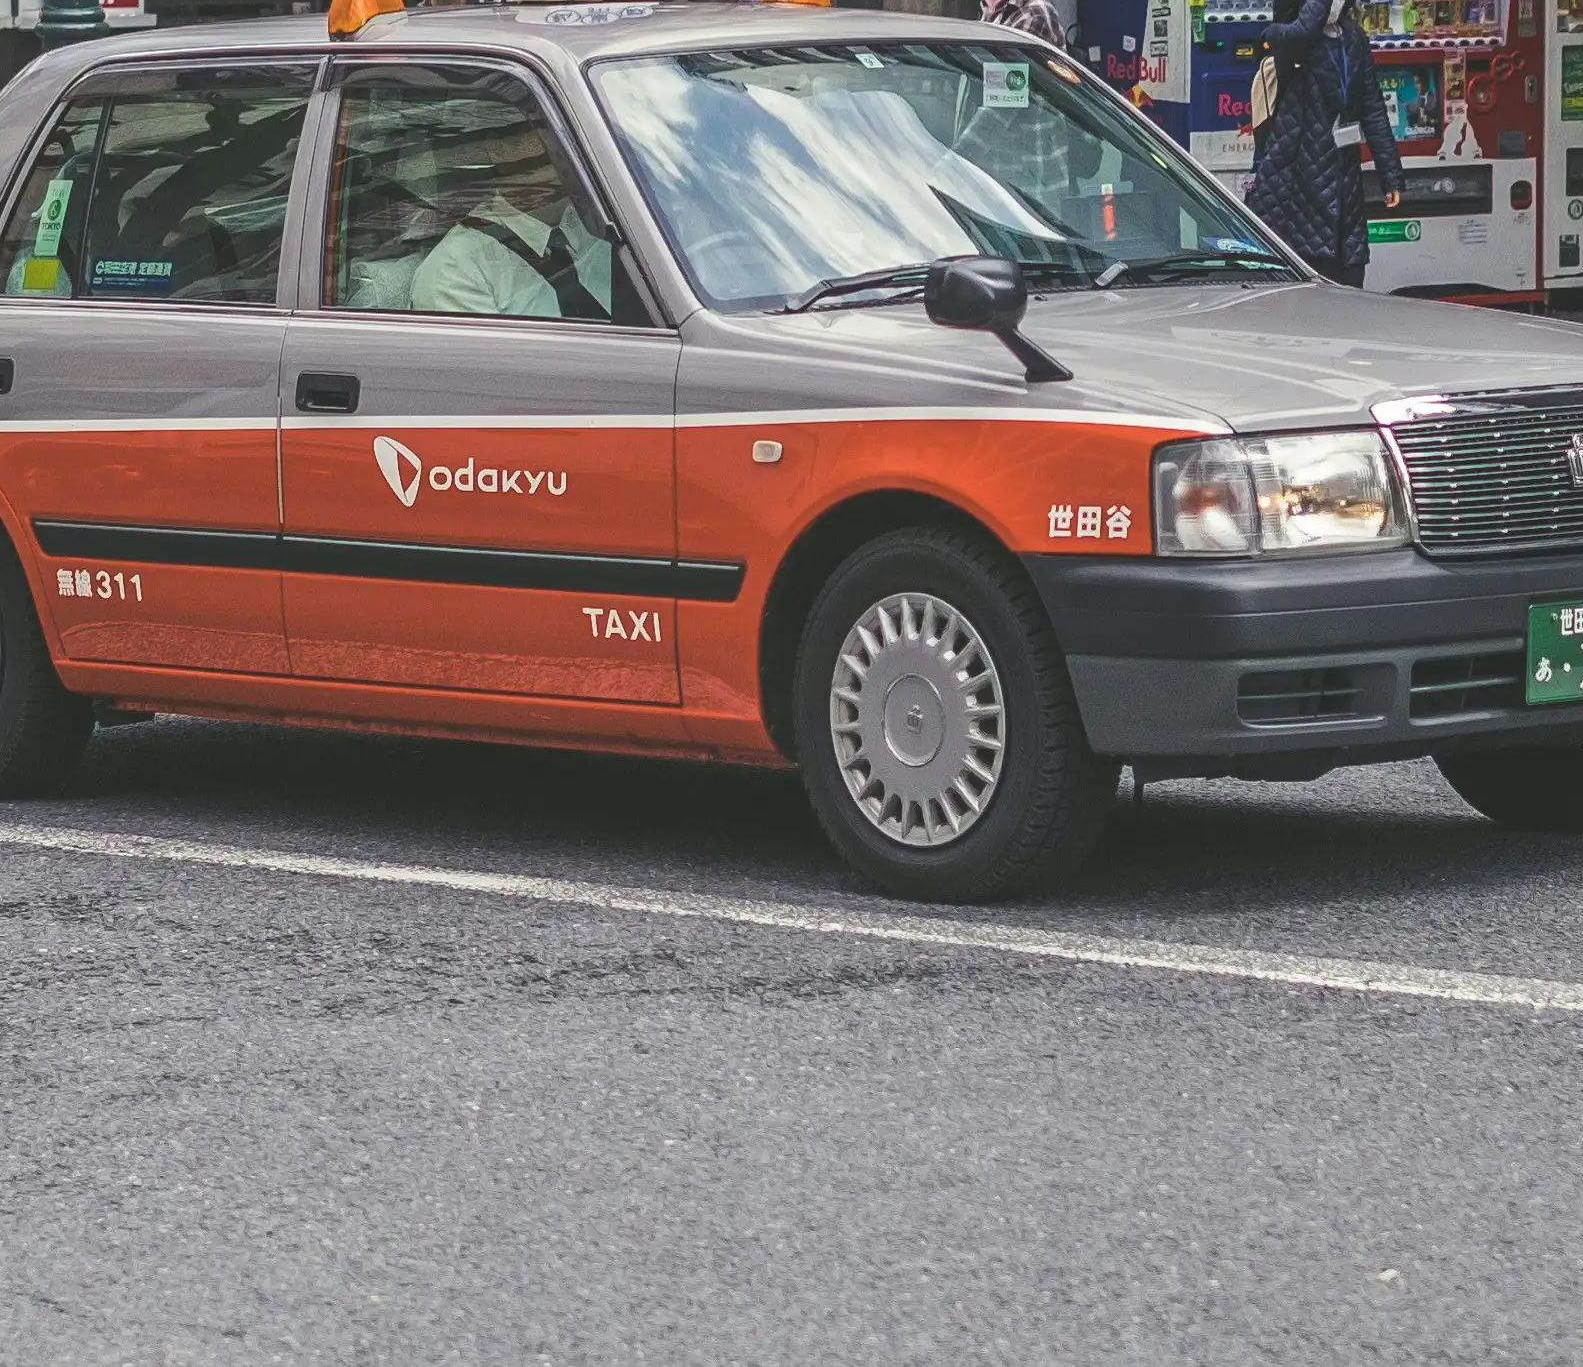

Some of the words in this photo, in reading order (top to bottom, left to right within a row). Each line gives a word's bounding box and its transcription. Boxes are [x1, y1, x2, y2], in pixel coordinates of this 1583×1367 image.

[1107, 53, 1137, 80] Red
[1138, 56, 1167, 83] Bull
[428, 457, 568, 496] odakyu
[1047, 504, 1133, 540] 世田谷
[582, 607, 663, 643] TAXI
[1535, 656, 1552, 682] あ
